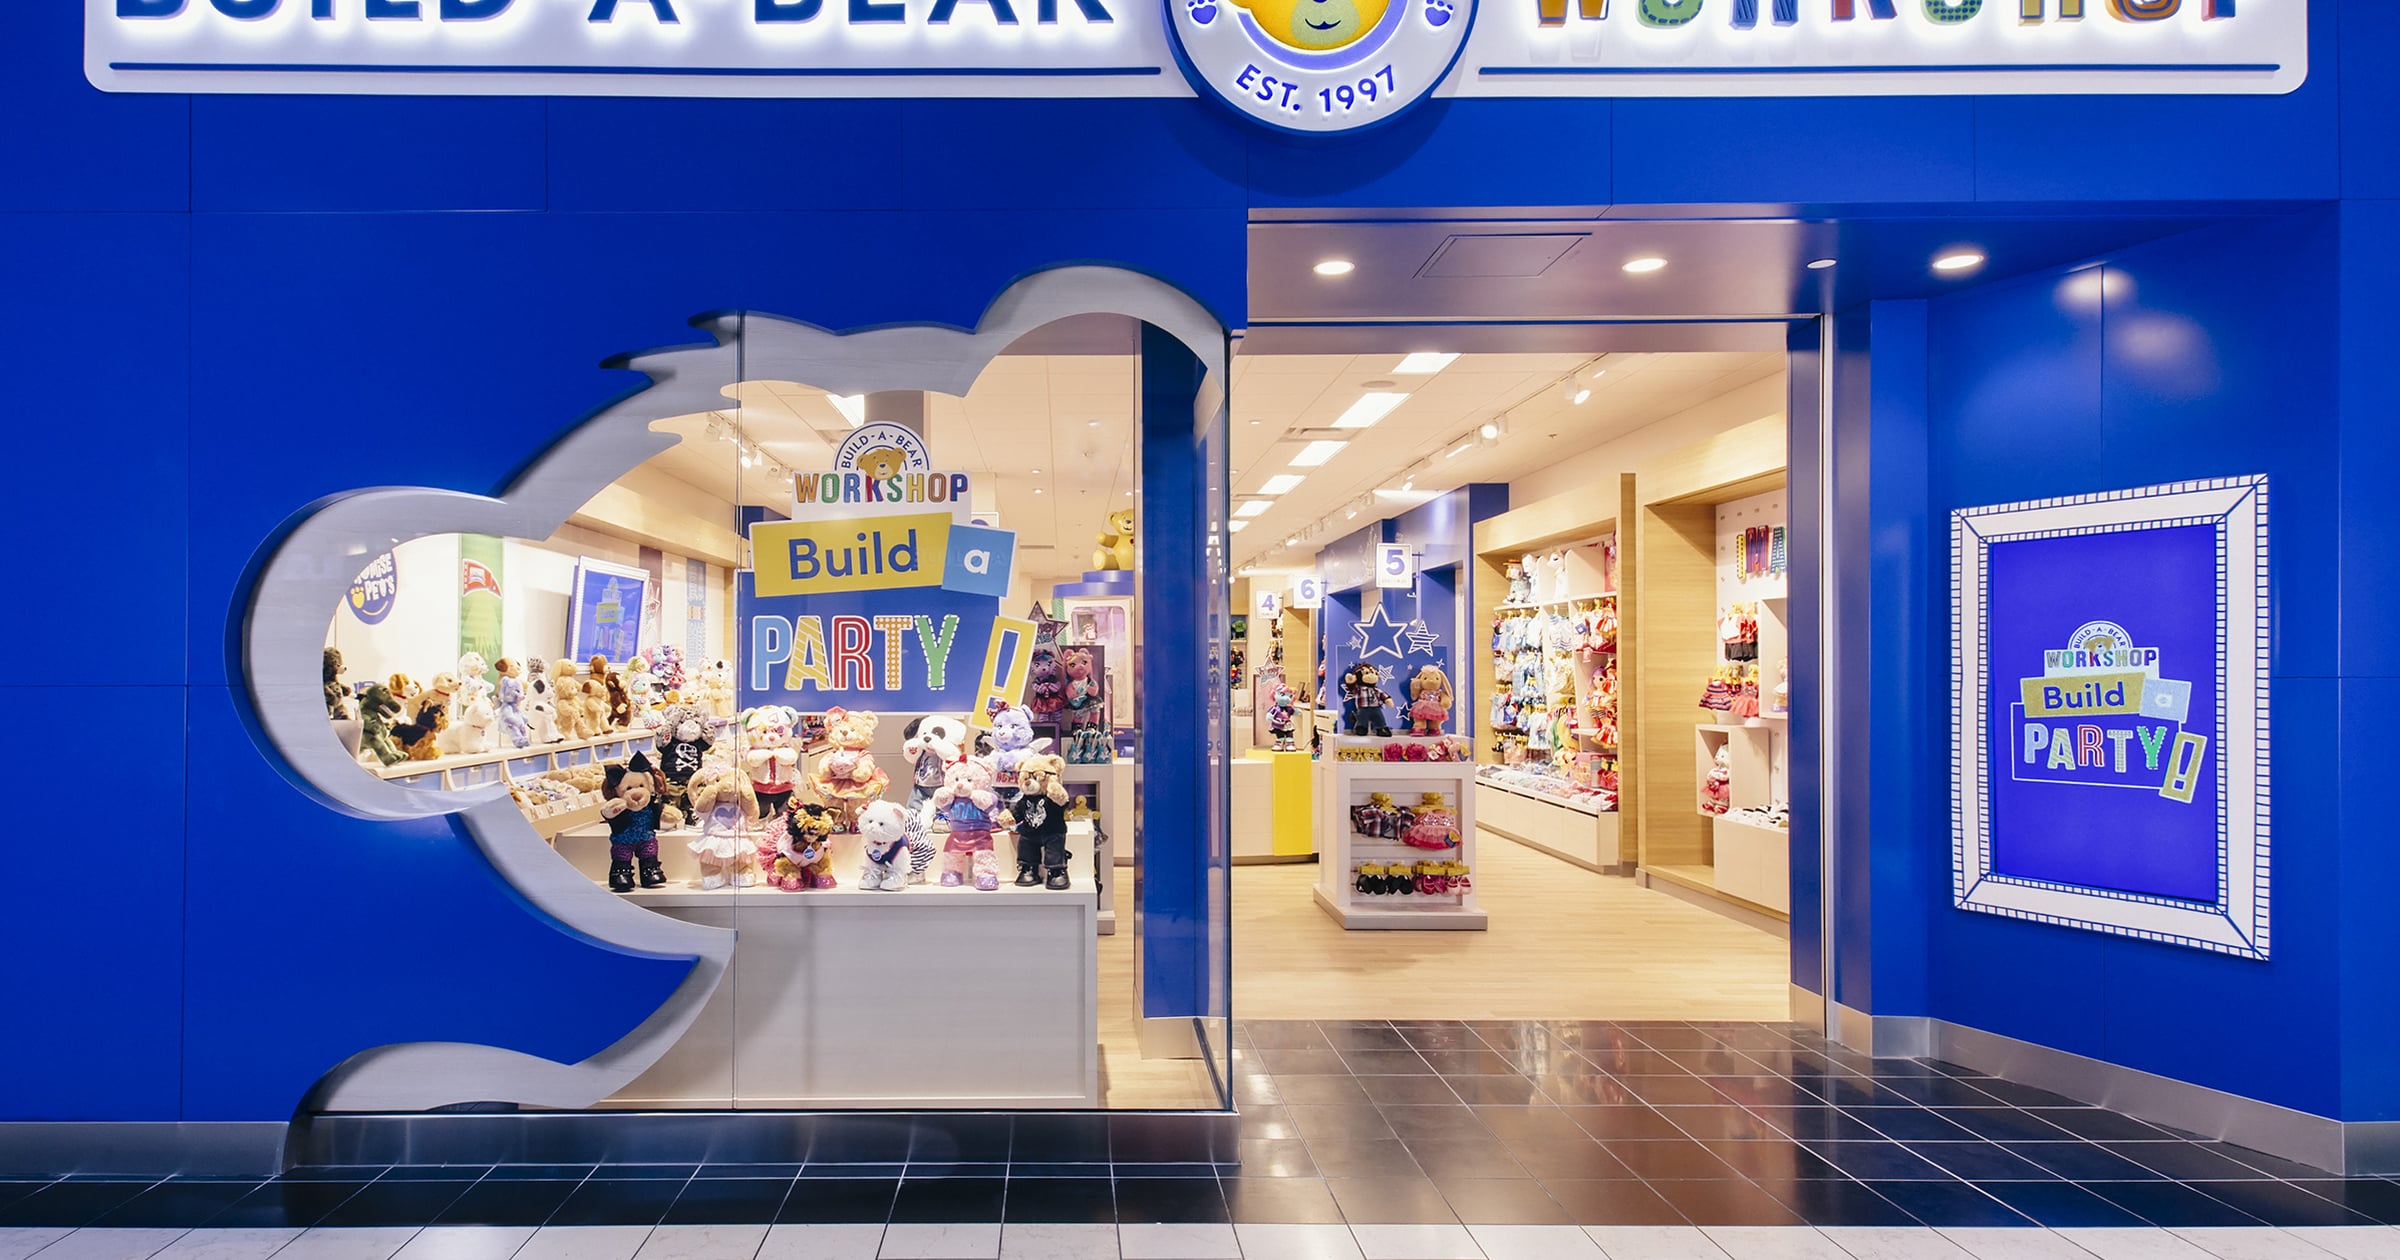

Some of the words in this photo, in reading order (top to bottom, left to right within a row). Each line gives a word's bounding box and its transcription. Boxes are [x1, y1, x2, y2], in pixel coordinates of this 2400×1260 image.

[1236, 64, 1301, 111] EST.
[1319, 64, 1395, 112] 1997
[795, 473, 968, 503] WORKSHOP
[789, 529, 919, 580] Build
[963, 548, 991, 575] a
[1386, 549, 1405, 575] 5
[365, 575, 395, 601] PETS
[1300, 579, 1315, 600] 6
[1261, 594, 1275, 611] 4
[2046, 649, 2157, 668] WORKSHOP
[2043, 681, 2125, 710] Build
[2155, 693, 2173, 708] a
